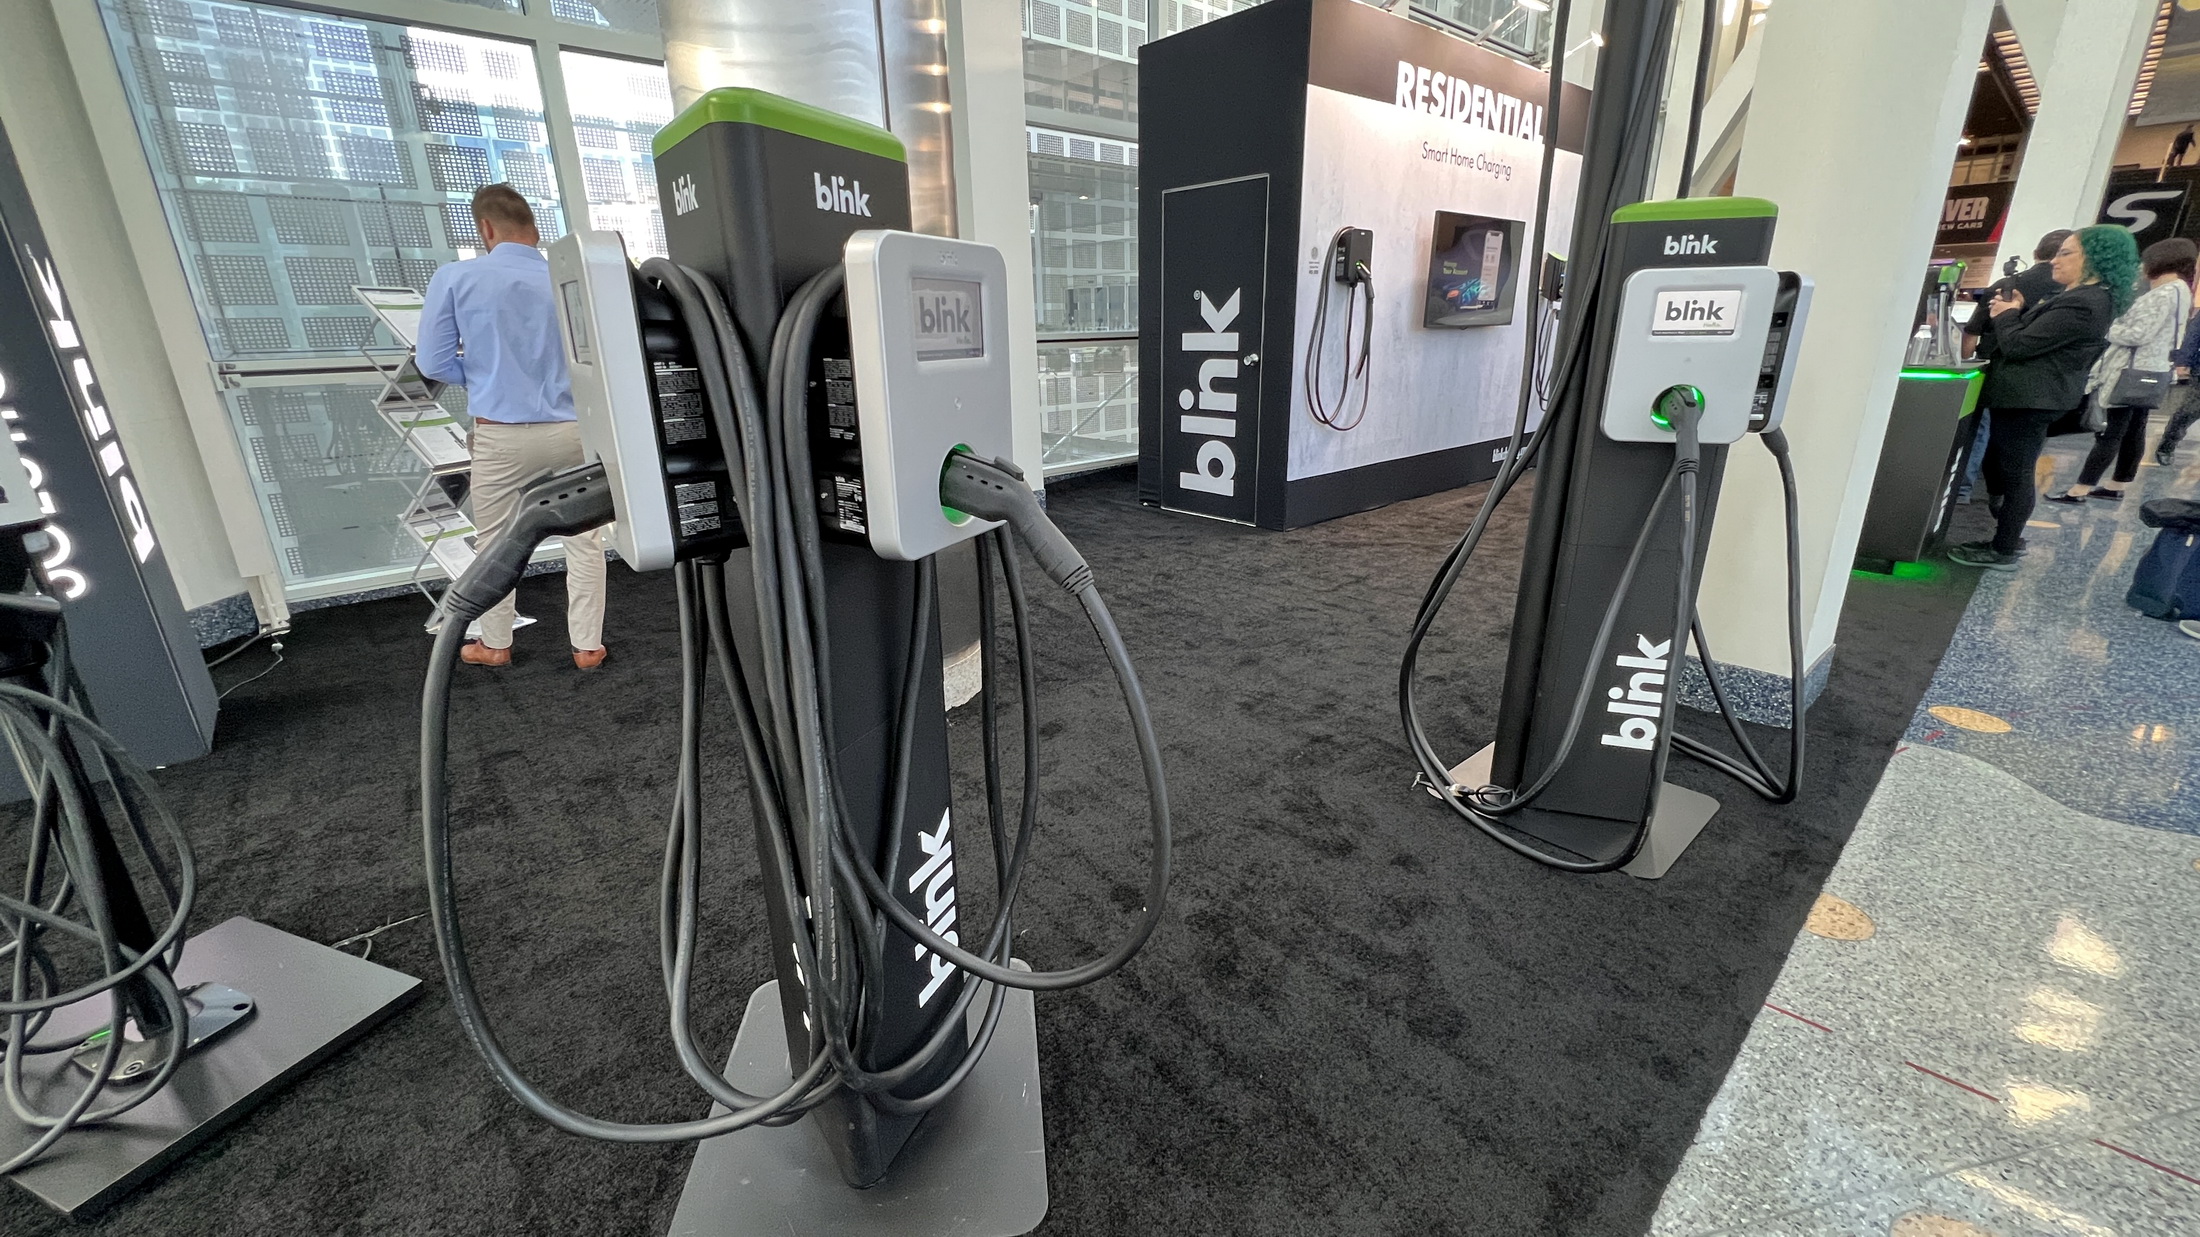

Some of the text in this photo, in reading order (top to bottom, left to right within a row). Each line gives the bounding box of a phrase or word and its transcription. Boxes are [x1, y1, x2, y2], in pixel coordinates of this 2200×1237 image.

[1395, 60, 1545, 144] RESIDENTIAL
[1422, 141, 1512, 181] Smart Home Charging
[672, 174, 699, 216] blink
[814, 172, 872, 217] blink
[1945, 196, 1990, 222] VER
[1663, 234, 1718, 255] blink
[1939, 221, 1984, 231] EW CARS
[919, 296, 971, 333] blink
[1665, 300, 1725, 321] blink
[1179, 287, 1241, 497] blink
[1601, 634, 1671, 750] blink
